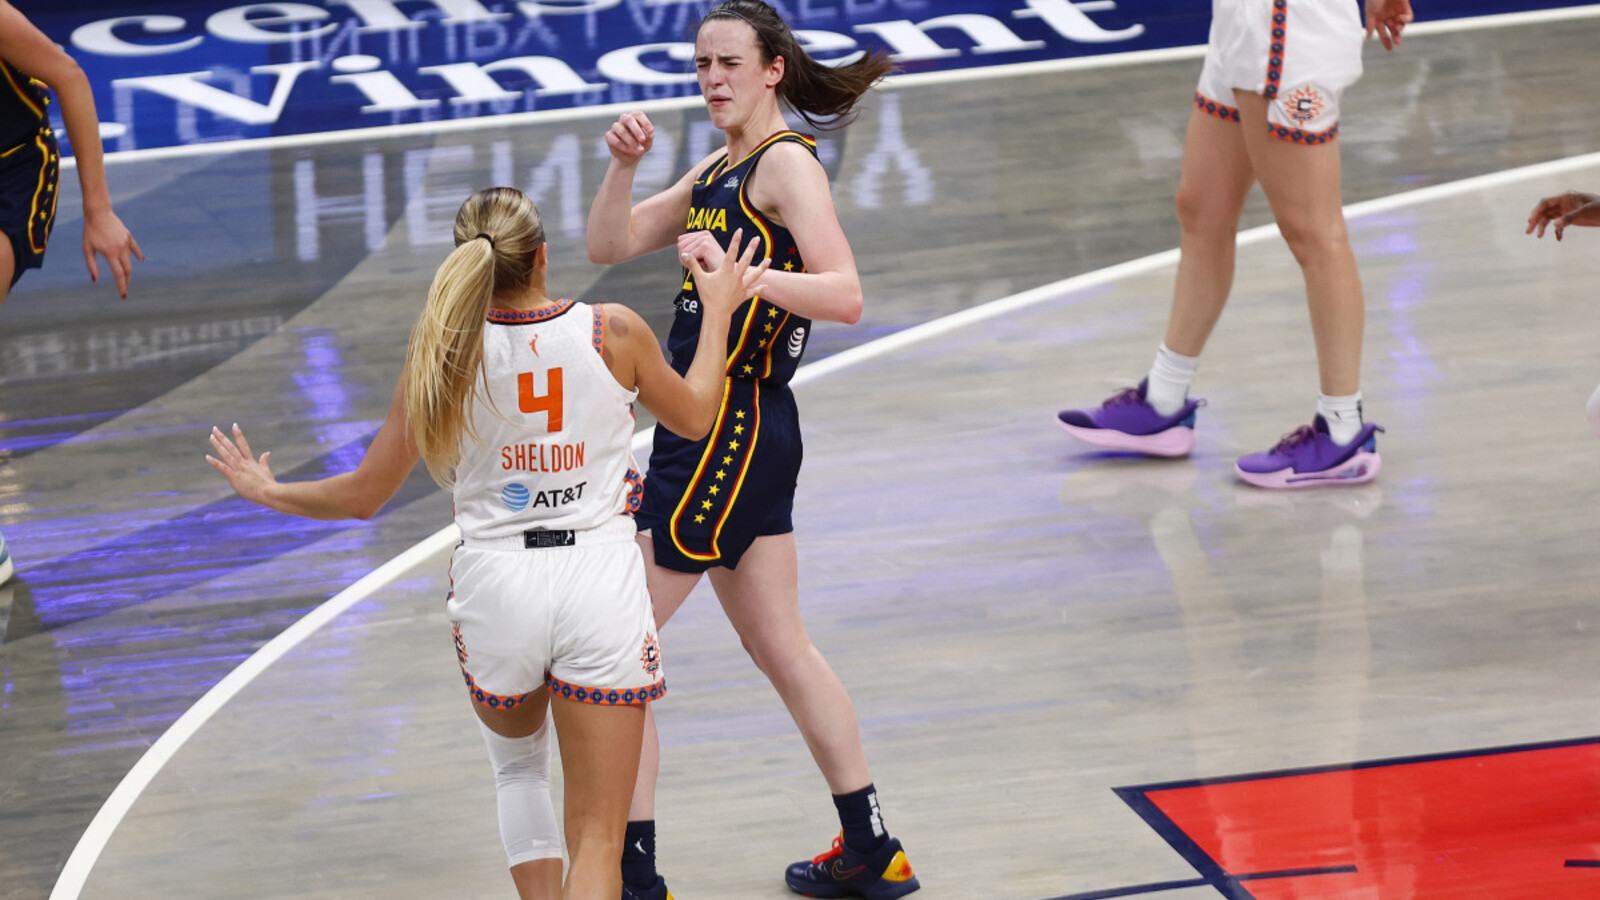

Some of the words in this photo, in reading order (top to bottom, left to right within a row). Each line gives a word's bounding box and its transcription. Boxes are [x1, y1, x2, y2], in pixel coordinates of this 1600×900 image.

[111, 0, 1146, 125] Vincent
[517, 366, 563, 433] 4
[501, 441, 586, 474] SHELDON
[532, 481, 588, 508] AT&T
